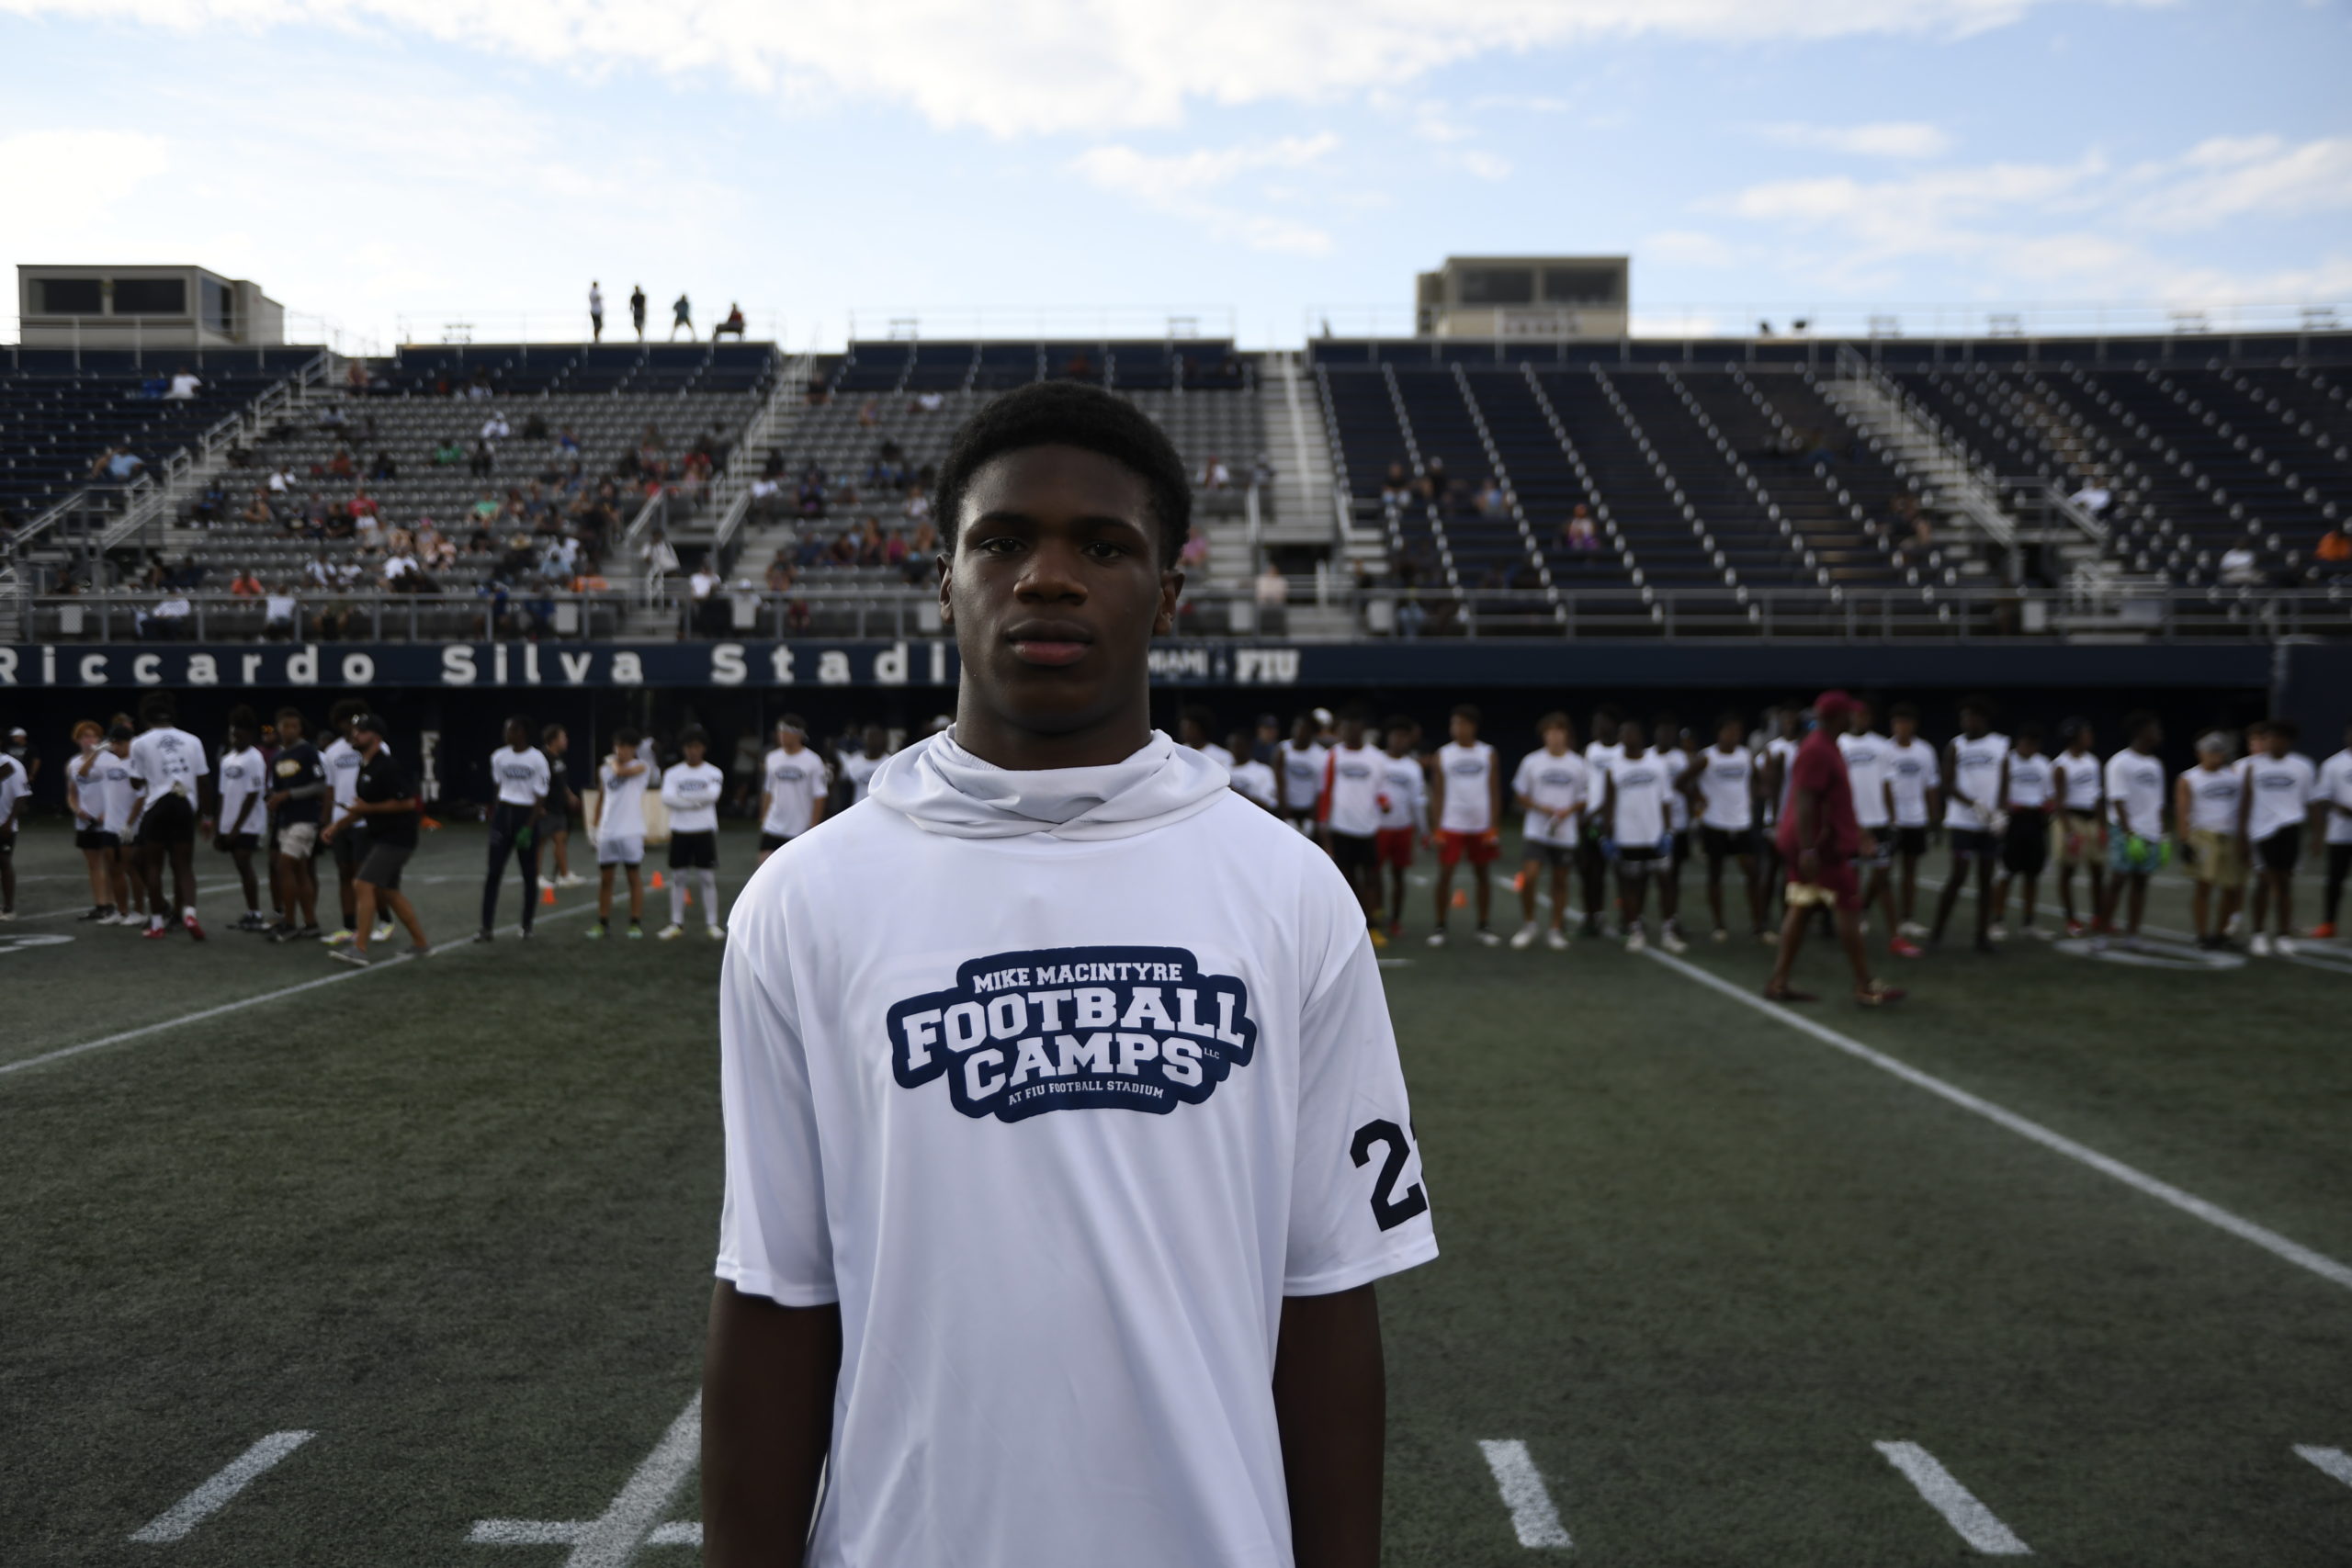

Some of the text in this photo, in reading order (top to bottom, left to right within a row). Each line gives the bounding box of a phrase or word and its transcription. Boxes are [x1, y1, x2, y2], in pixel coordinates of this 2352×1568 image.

[0, 643, 946, 685] Riccardo Silva Stadi
[1235, 648, 1299, 683] FIU
[973, 963, 1182, 994] MIKE MACINTYRE
[902, 987, 1245, 1072] FOOTBALL
[964, 1032, 1203, 1101] CAMPS
[1204, 1047, 1220, 1059] LLC
[1009, 1080, 1164, 1105] AT FIU FOOTBALL STADIUM
[1350, 1118, 1428, 1232] 2
